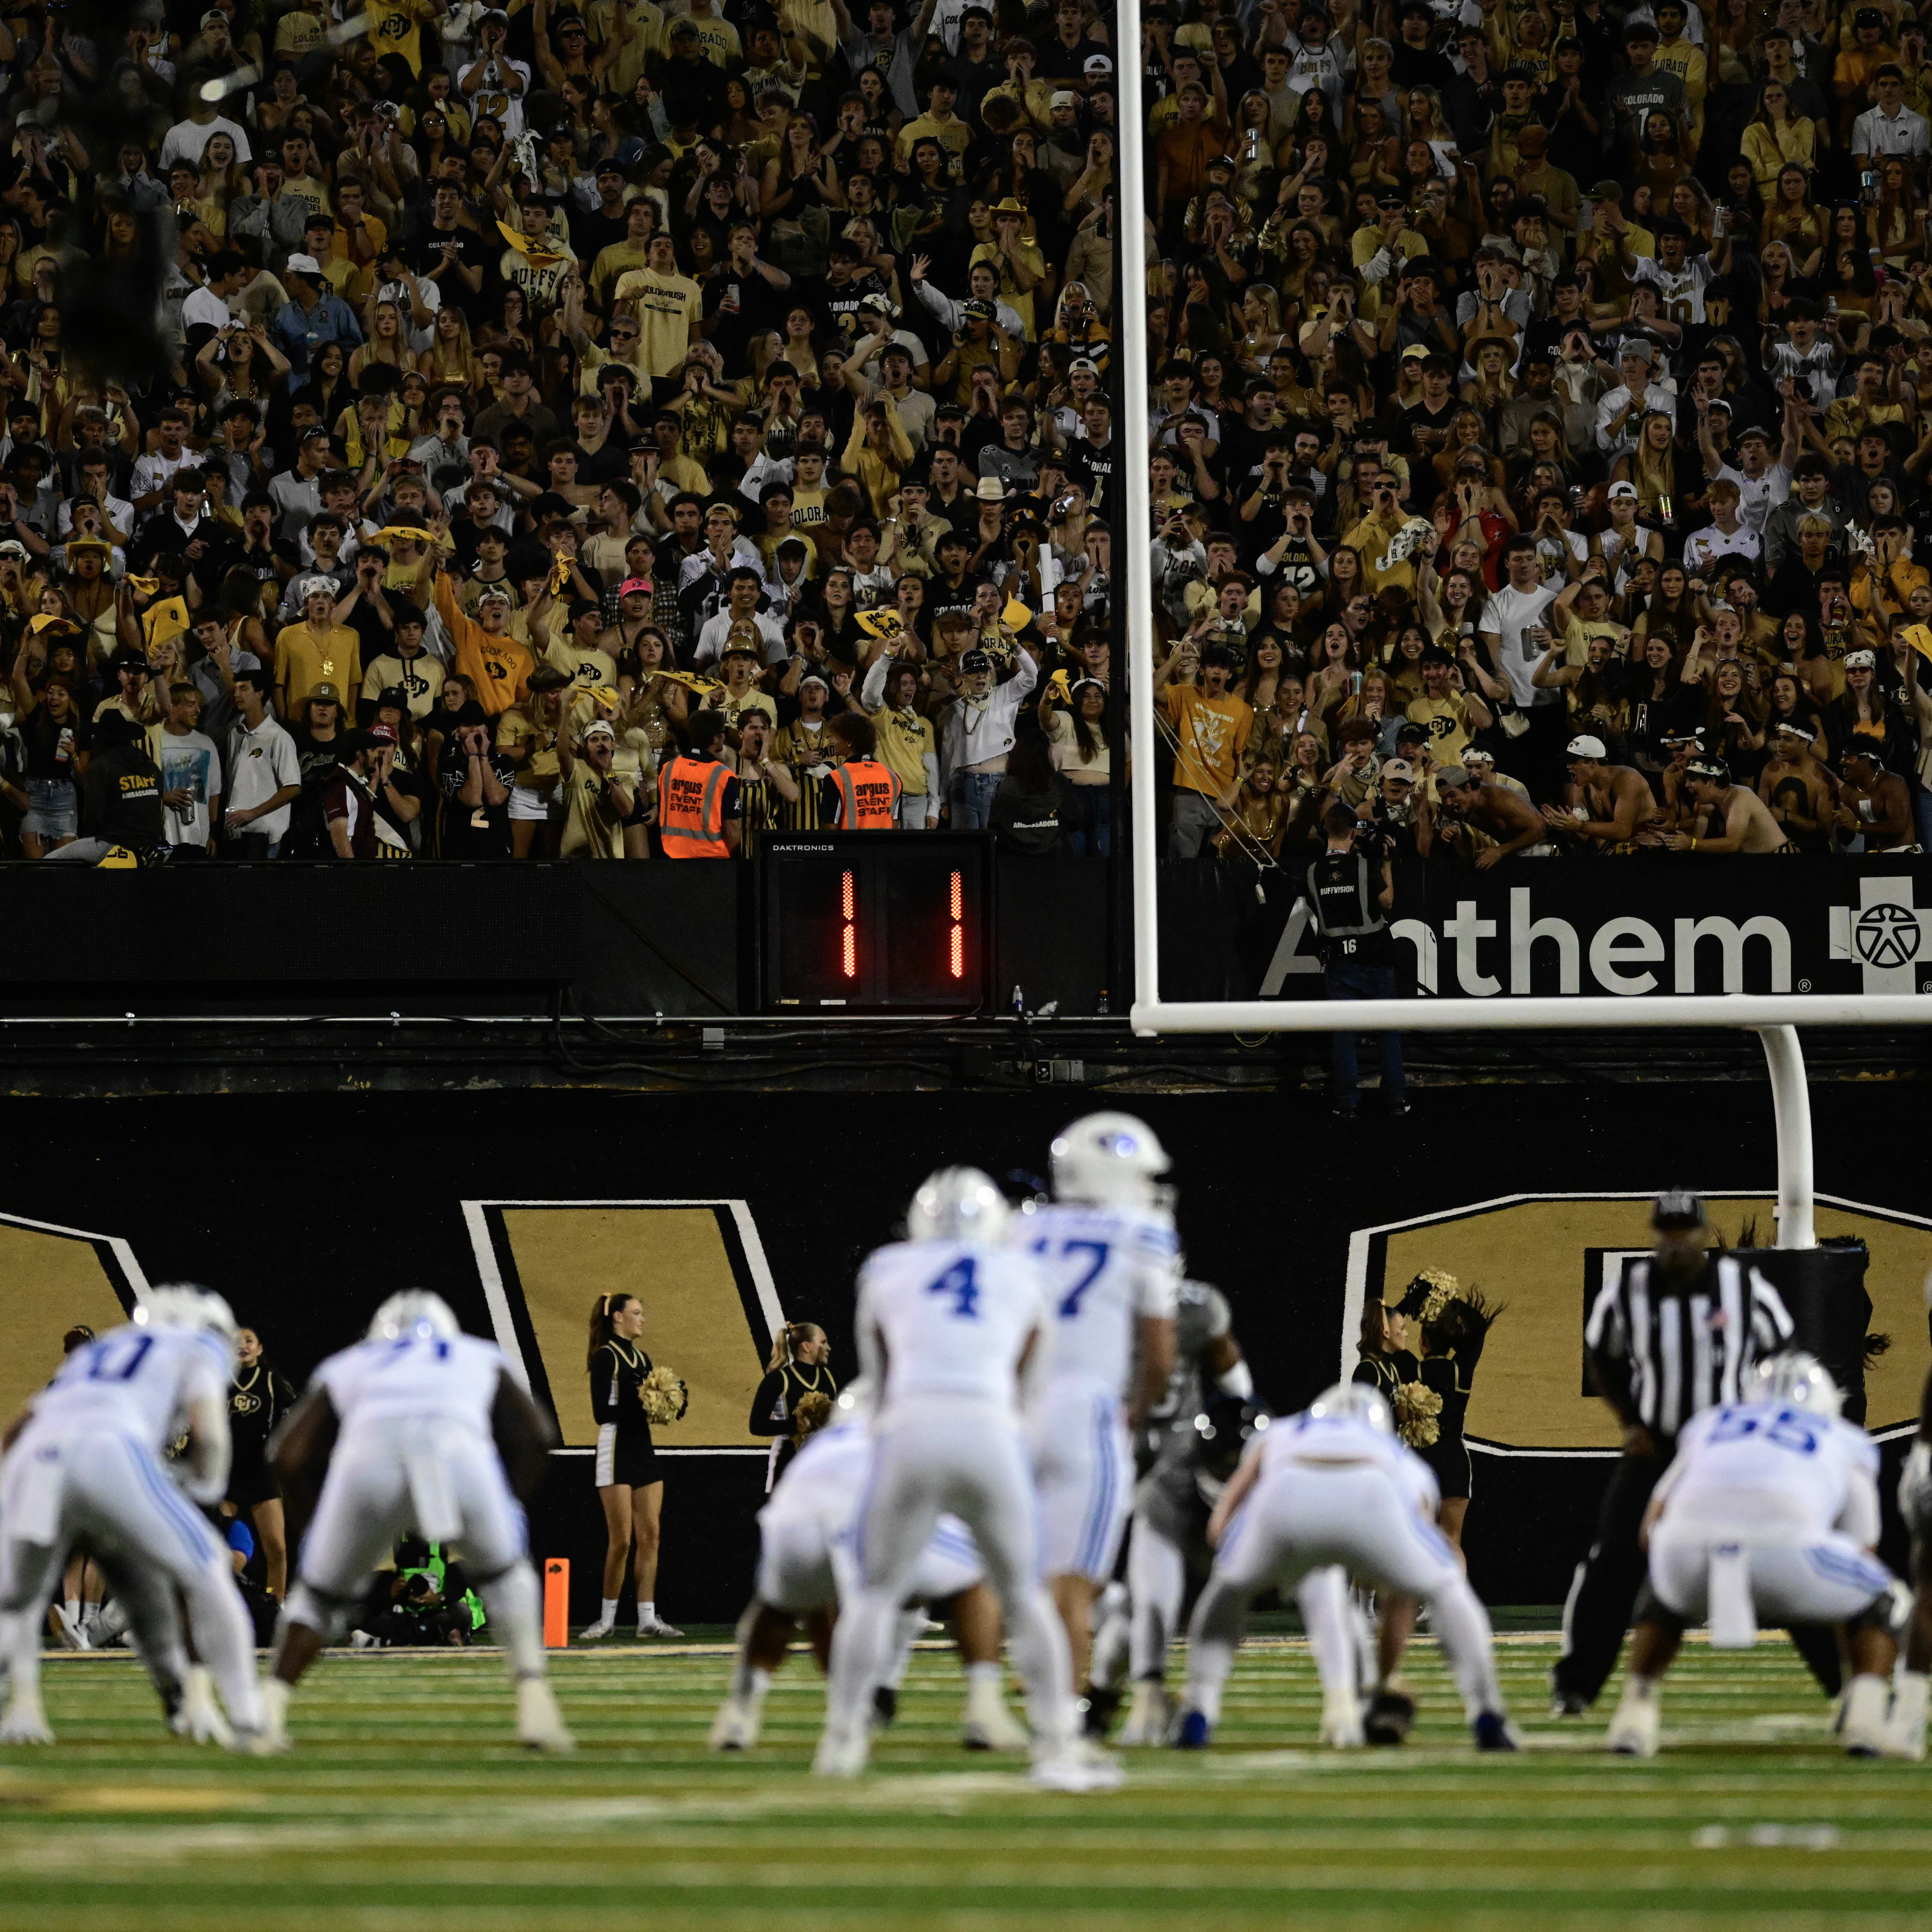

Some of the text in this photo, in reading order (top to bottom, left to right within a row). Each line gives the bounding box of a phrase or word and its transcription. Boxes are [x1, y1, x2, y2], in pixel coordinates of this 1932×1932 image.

[1652, 59, 1687, 75] LORADO
[1624, 94, 1664, 106] COLORADO
[667, 289, 686, 302] RUSH
[671, 778, 703, 794] argus
[856, 782, 890, 797] argus
[671, 793, 702, 805] EVENT
[857, 796, 890, 808] EVENT
[670, 803, 701, 815] STAFF
[857, 807, 891, 817] STAFF
[1013, 819, 1059, 829] AMBASSADORS
[1320, 885, 1355, 896] BUFFVISION
[1342, 939, 1357, 955] 16
[929, 1258, 979, 1319] 4
